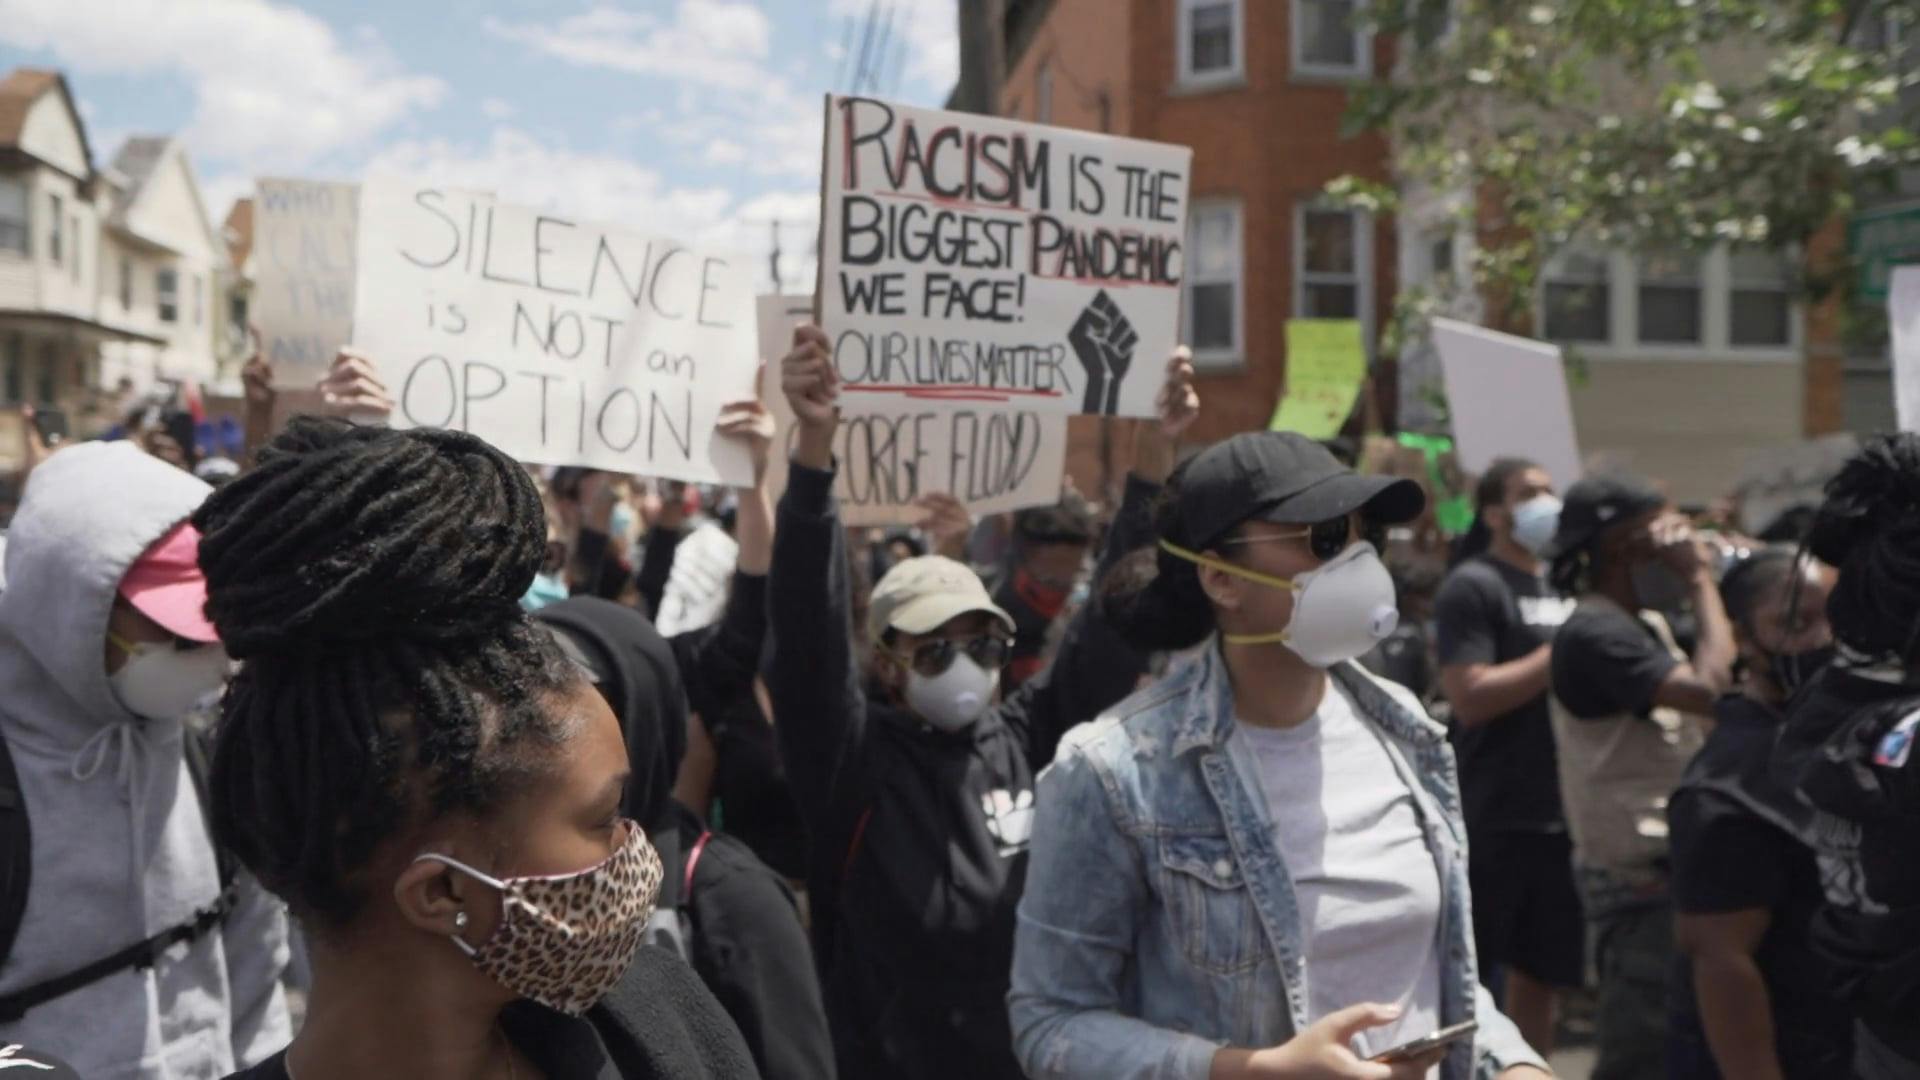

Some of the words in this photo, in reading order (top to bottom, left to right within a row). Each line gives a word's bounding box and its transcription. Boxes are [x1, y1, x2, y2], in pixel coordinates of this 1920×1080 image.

[838, 97, 1050, 211] RACISM
[1069, 153, 1105, 215] IS
[1116, 164, 1182, 223] THE
[399, 189, 734, 328] SILENCE
[840, 196, 1023, 270] BIGGEST
[1030, 213, 1182, 286] PANDEMIC
[426, 302, 468, 334] is
[512, 301, 624, 367] NOT
[646, 349, 697, 380] an
[840, 271, 906, 317] WE
[923, 273, 1026, 323] FACE!
[401, 354, 693, 461] OPTION
[786, 413, 938, 506] ORGE
